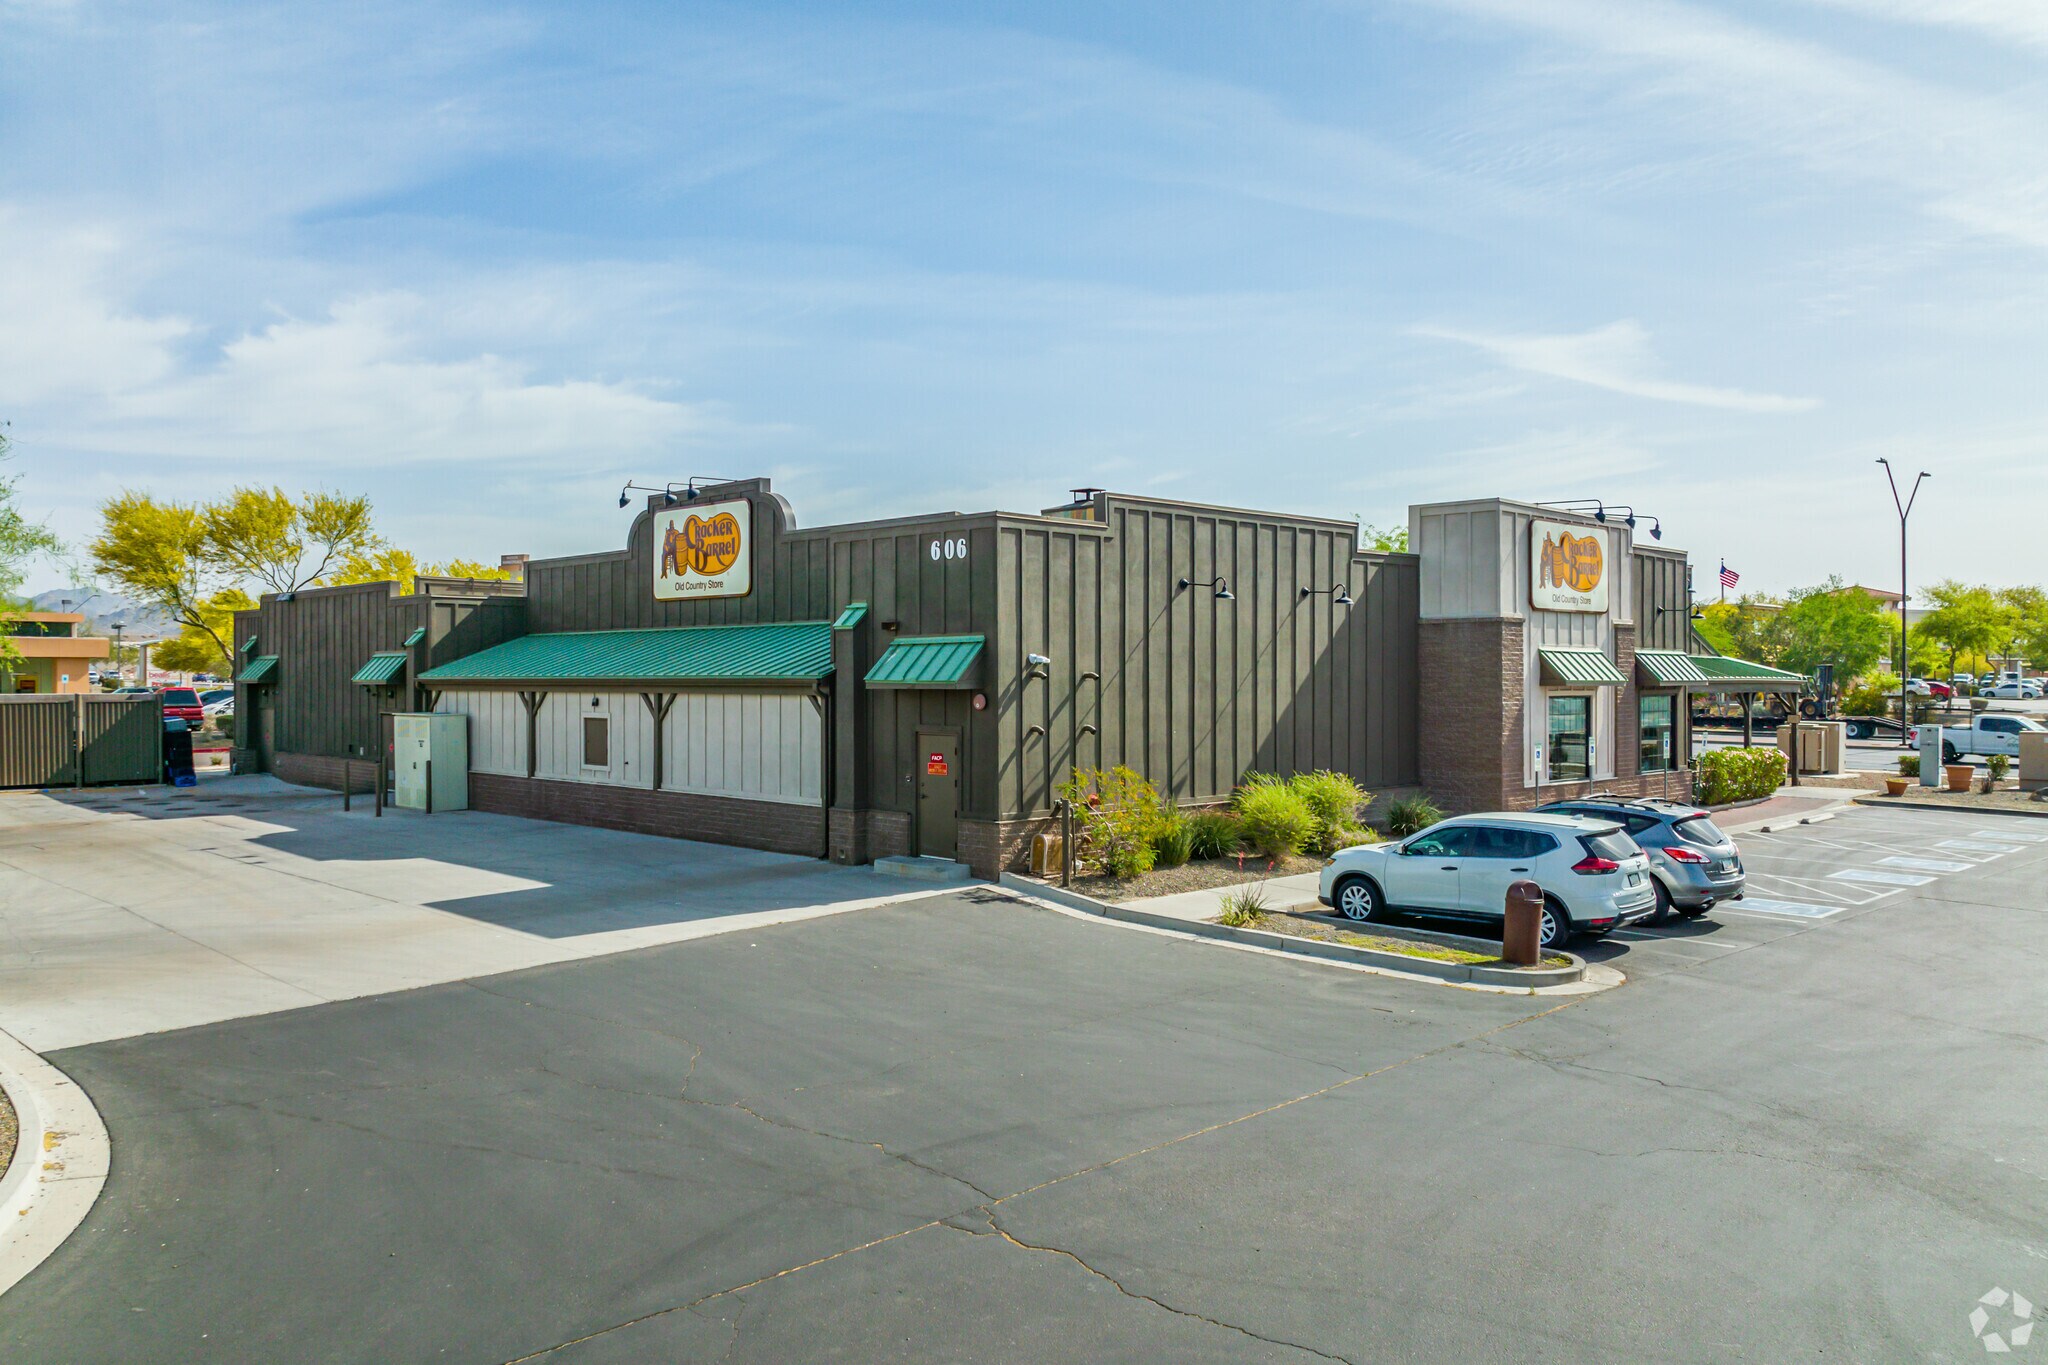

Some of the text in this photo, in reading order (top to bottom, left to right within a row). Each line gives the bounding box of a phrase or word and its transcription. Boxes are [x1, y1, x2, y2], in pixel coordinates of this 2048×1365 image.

[685, 517, 733, 549] Cracker
[695, 537, 736, 573] Barrel
[931, 538, 967, 560] 606
[675, 579, 724, 591] Old Country Store
[1552, 594, 1592, 606] Old Country Store
